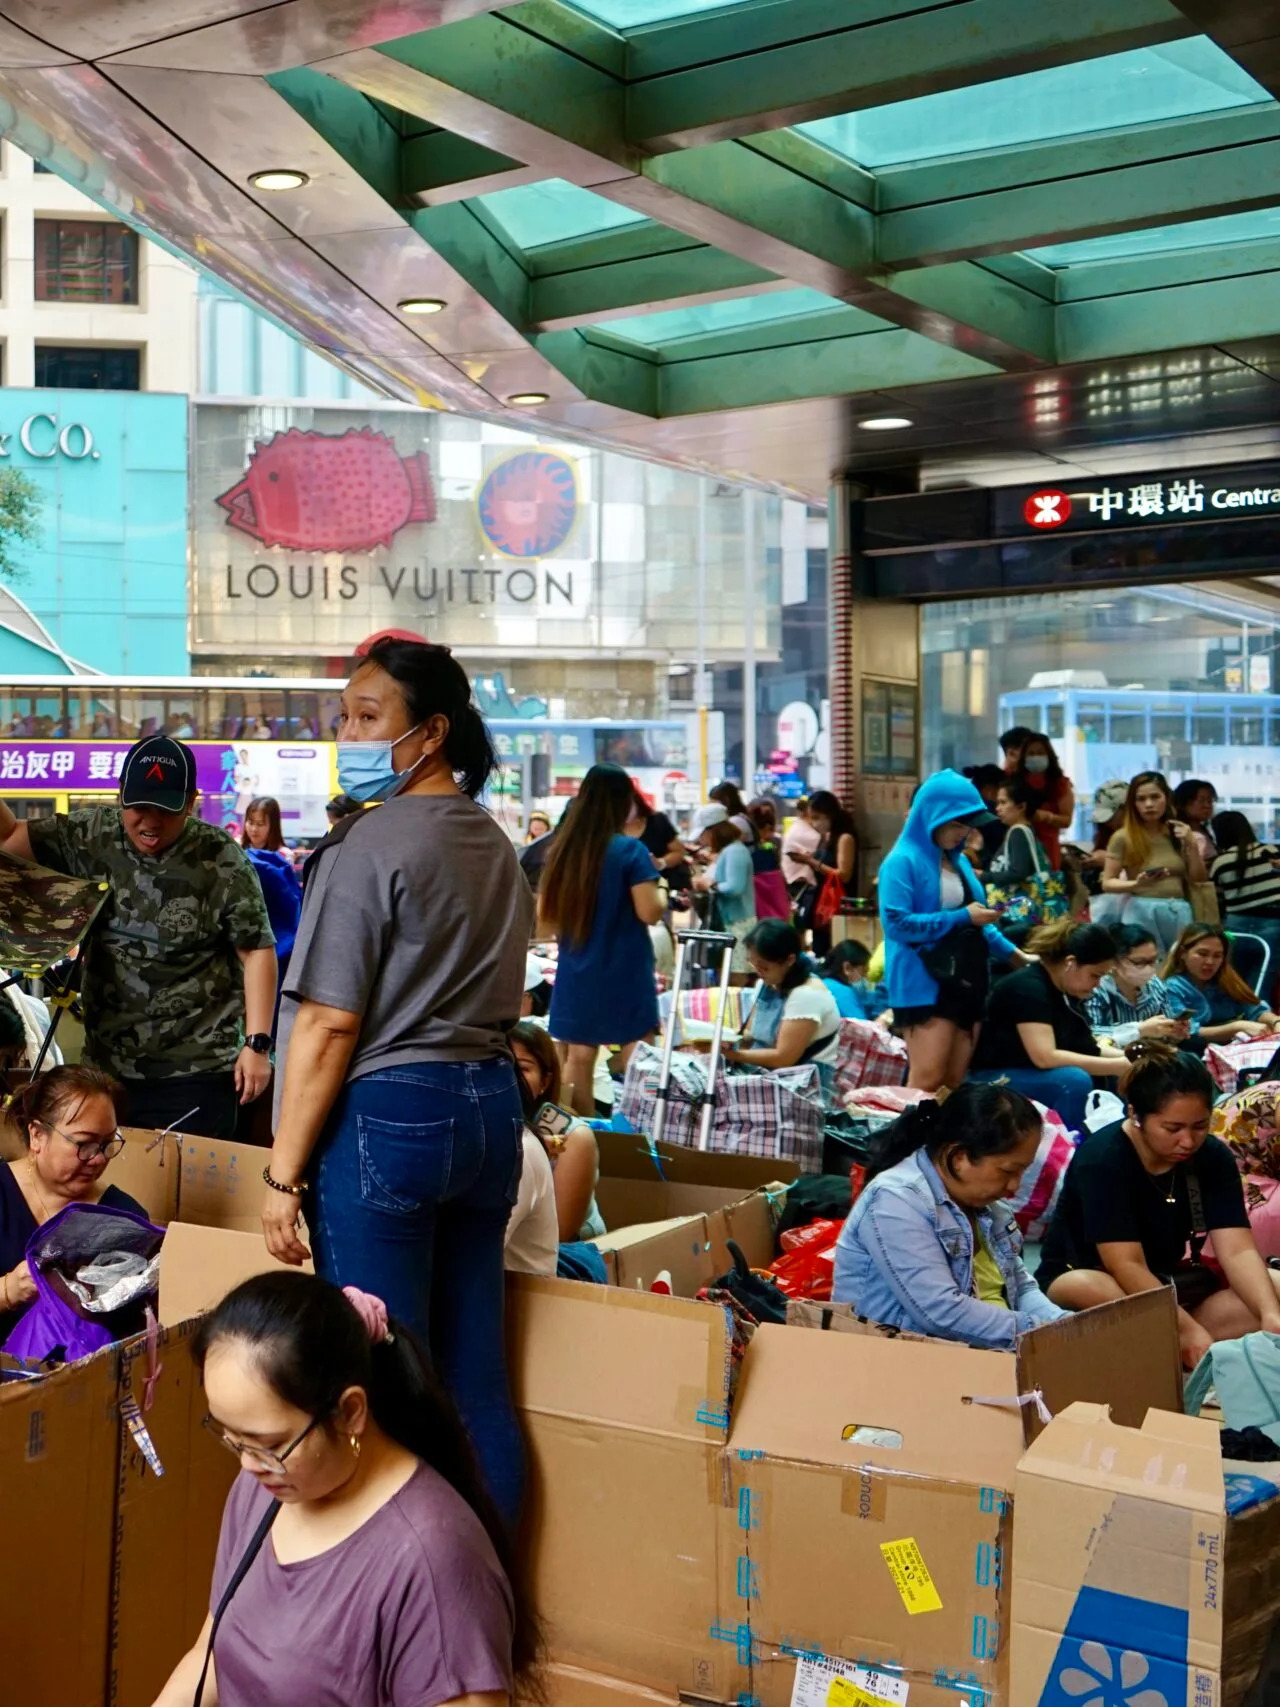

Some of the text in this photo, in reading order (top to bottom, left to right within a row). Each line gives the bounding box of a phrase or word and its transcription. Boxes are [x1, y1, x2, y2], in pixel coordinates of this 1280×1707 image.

[1088, 479, 1205, 521] 中環站
[226, 563, 574, 605] LOUIS VUITTON
[139, 754, 178, 768] ANTIGUA
[1203, 1558, 1219, 1610] 24x770
